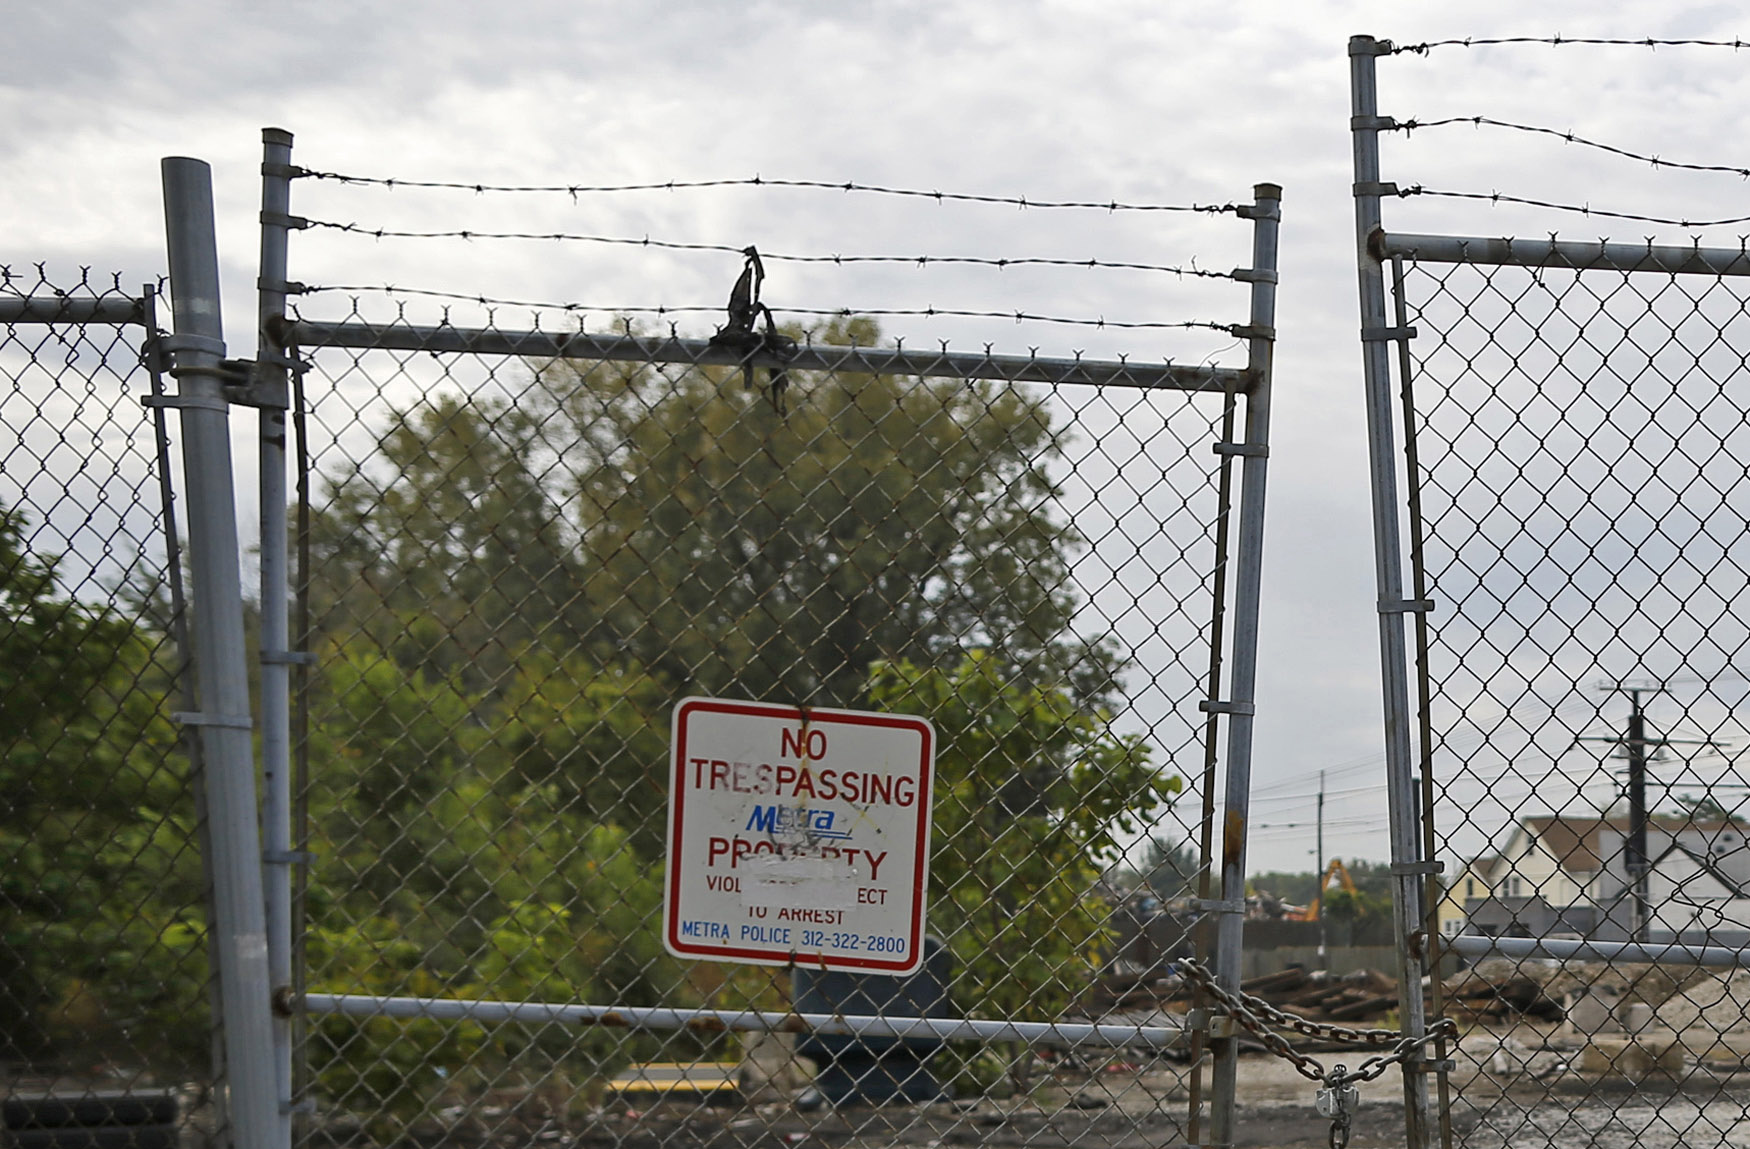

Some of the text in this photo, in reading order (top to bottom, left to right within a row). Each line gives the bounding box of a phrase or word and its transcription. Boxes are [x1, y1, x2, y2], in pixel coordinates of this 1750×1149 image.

[780, 728, 828, 760] NO
[690, 757, 915, 807] TRESPASSING
[745, 804, 835, 833] Metra
[707, 837, 888, 881] PROTY
[706, 875, 888, 905] VIOL ECT
[778, 908, 845, 925] ARREST
[682, 921, 905, 954] METRA POLICE 312-322-2800
